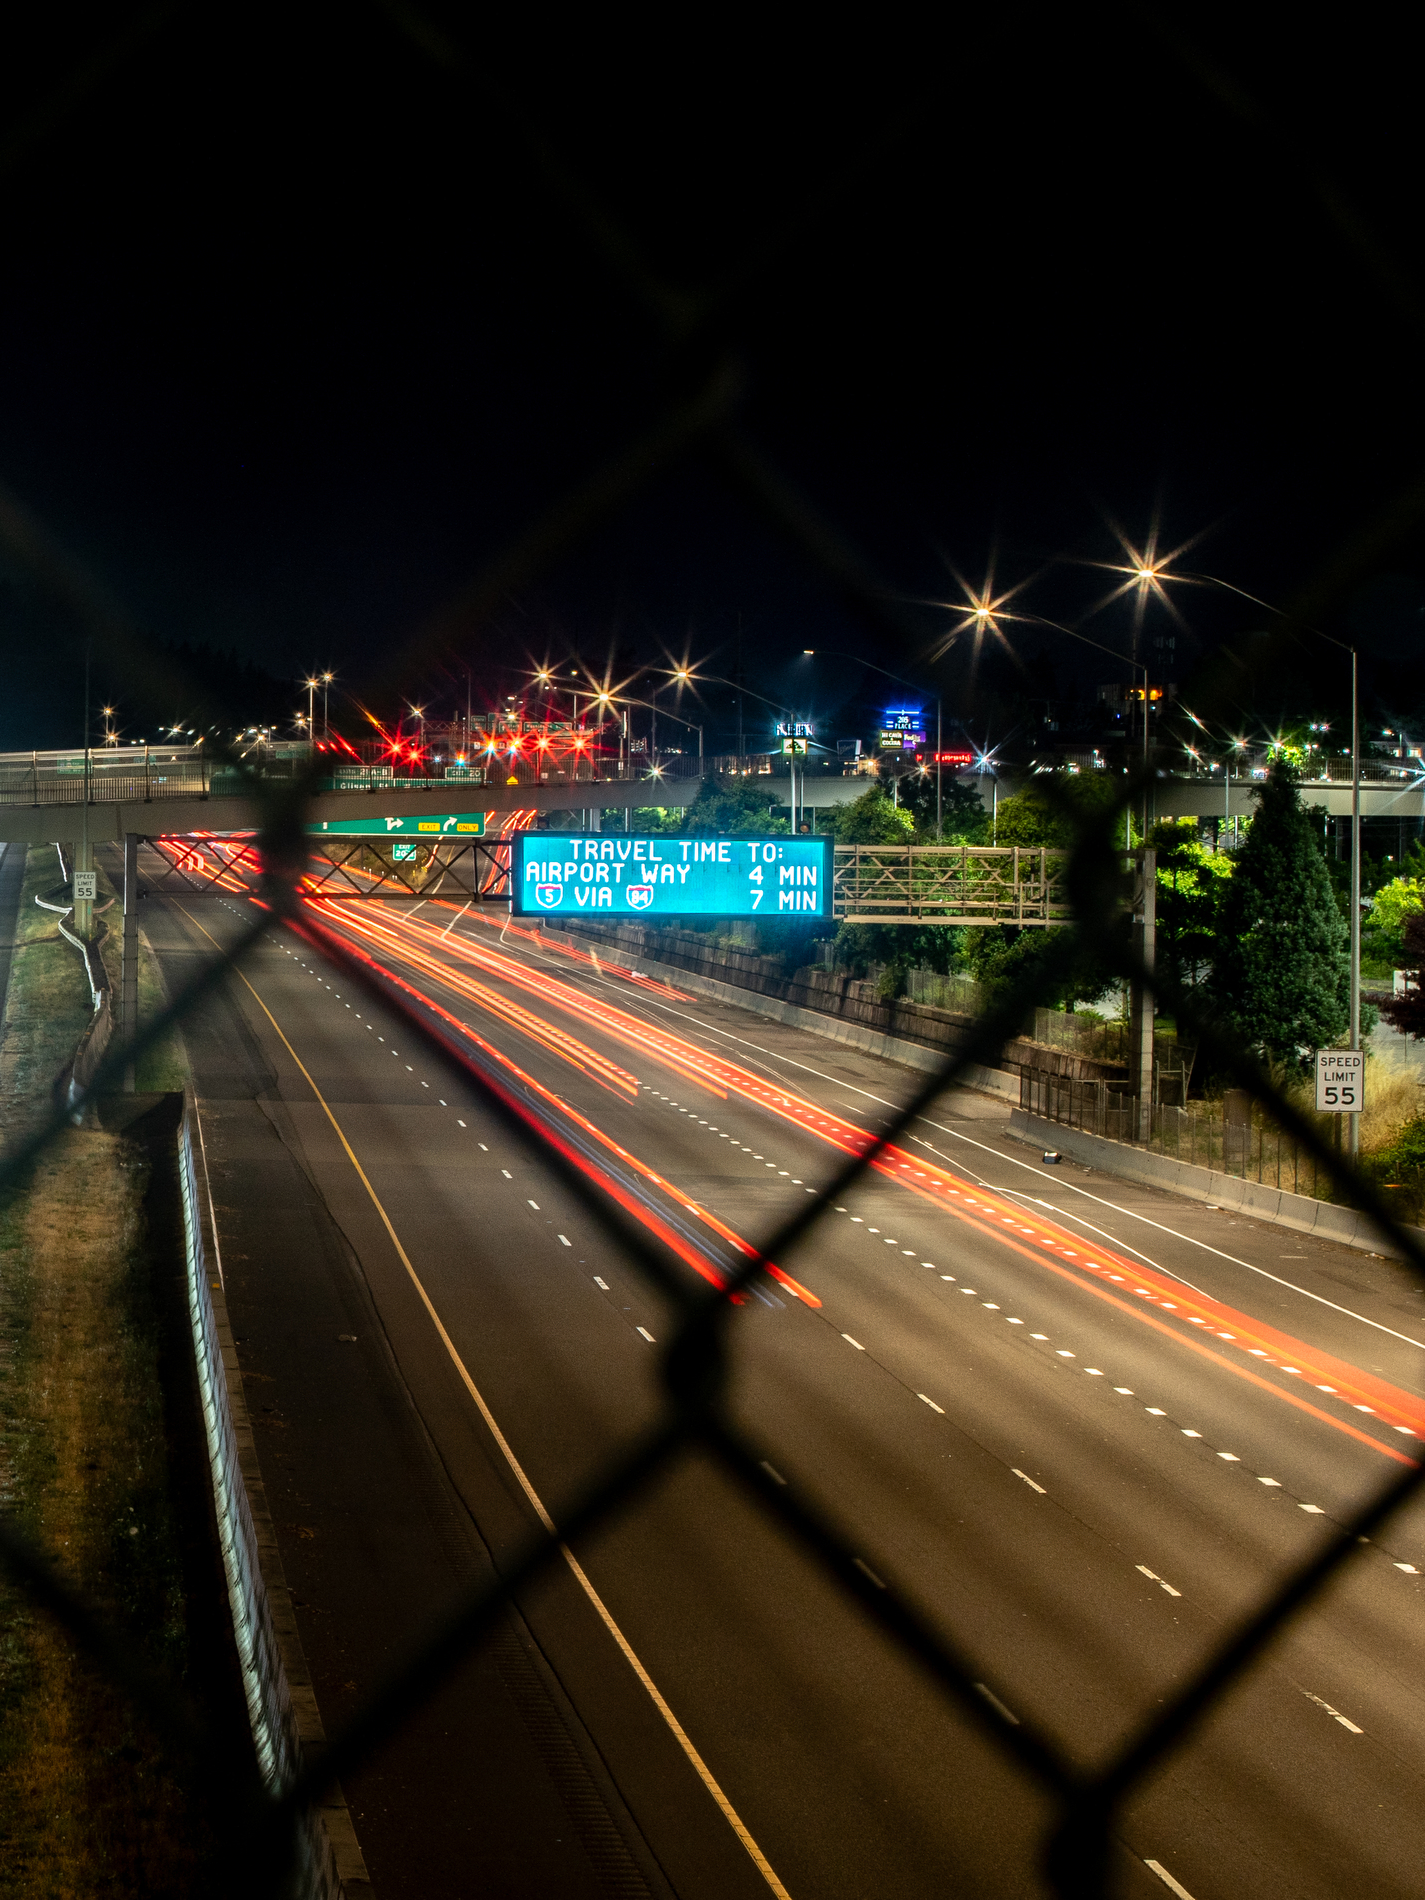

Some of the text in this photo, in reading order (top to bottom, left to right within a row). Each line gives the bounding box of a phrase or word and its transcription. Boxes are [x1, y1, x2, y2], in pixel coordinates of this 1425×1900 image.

[469, 769, 481, 777] 20
[569, 840, 783, 863] TRAVEL TIME TO:
[526, 861, 817, 886] AIRPORT WAY 4 MIN
[78, 887, 93, 897] 55
[545, 886, 817, 911] 5 VIA 84 7 MIN
[1320, 1057, 1360, 1067] SPEED
[1324, 1072, 1356, 1082] LIMIT
[1324, 1087, 1355, 1105] 55
